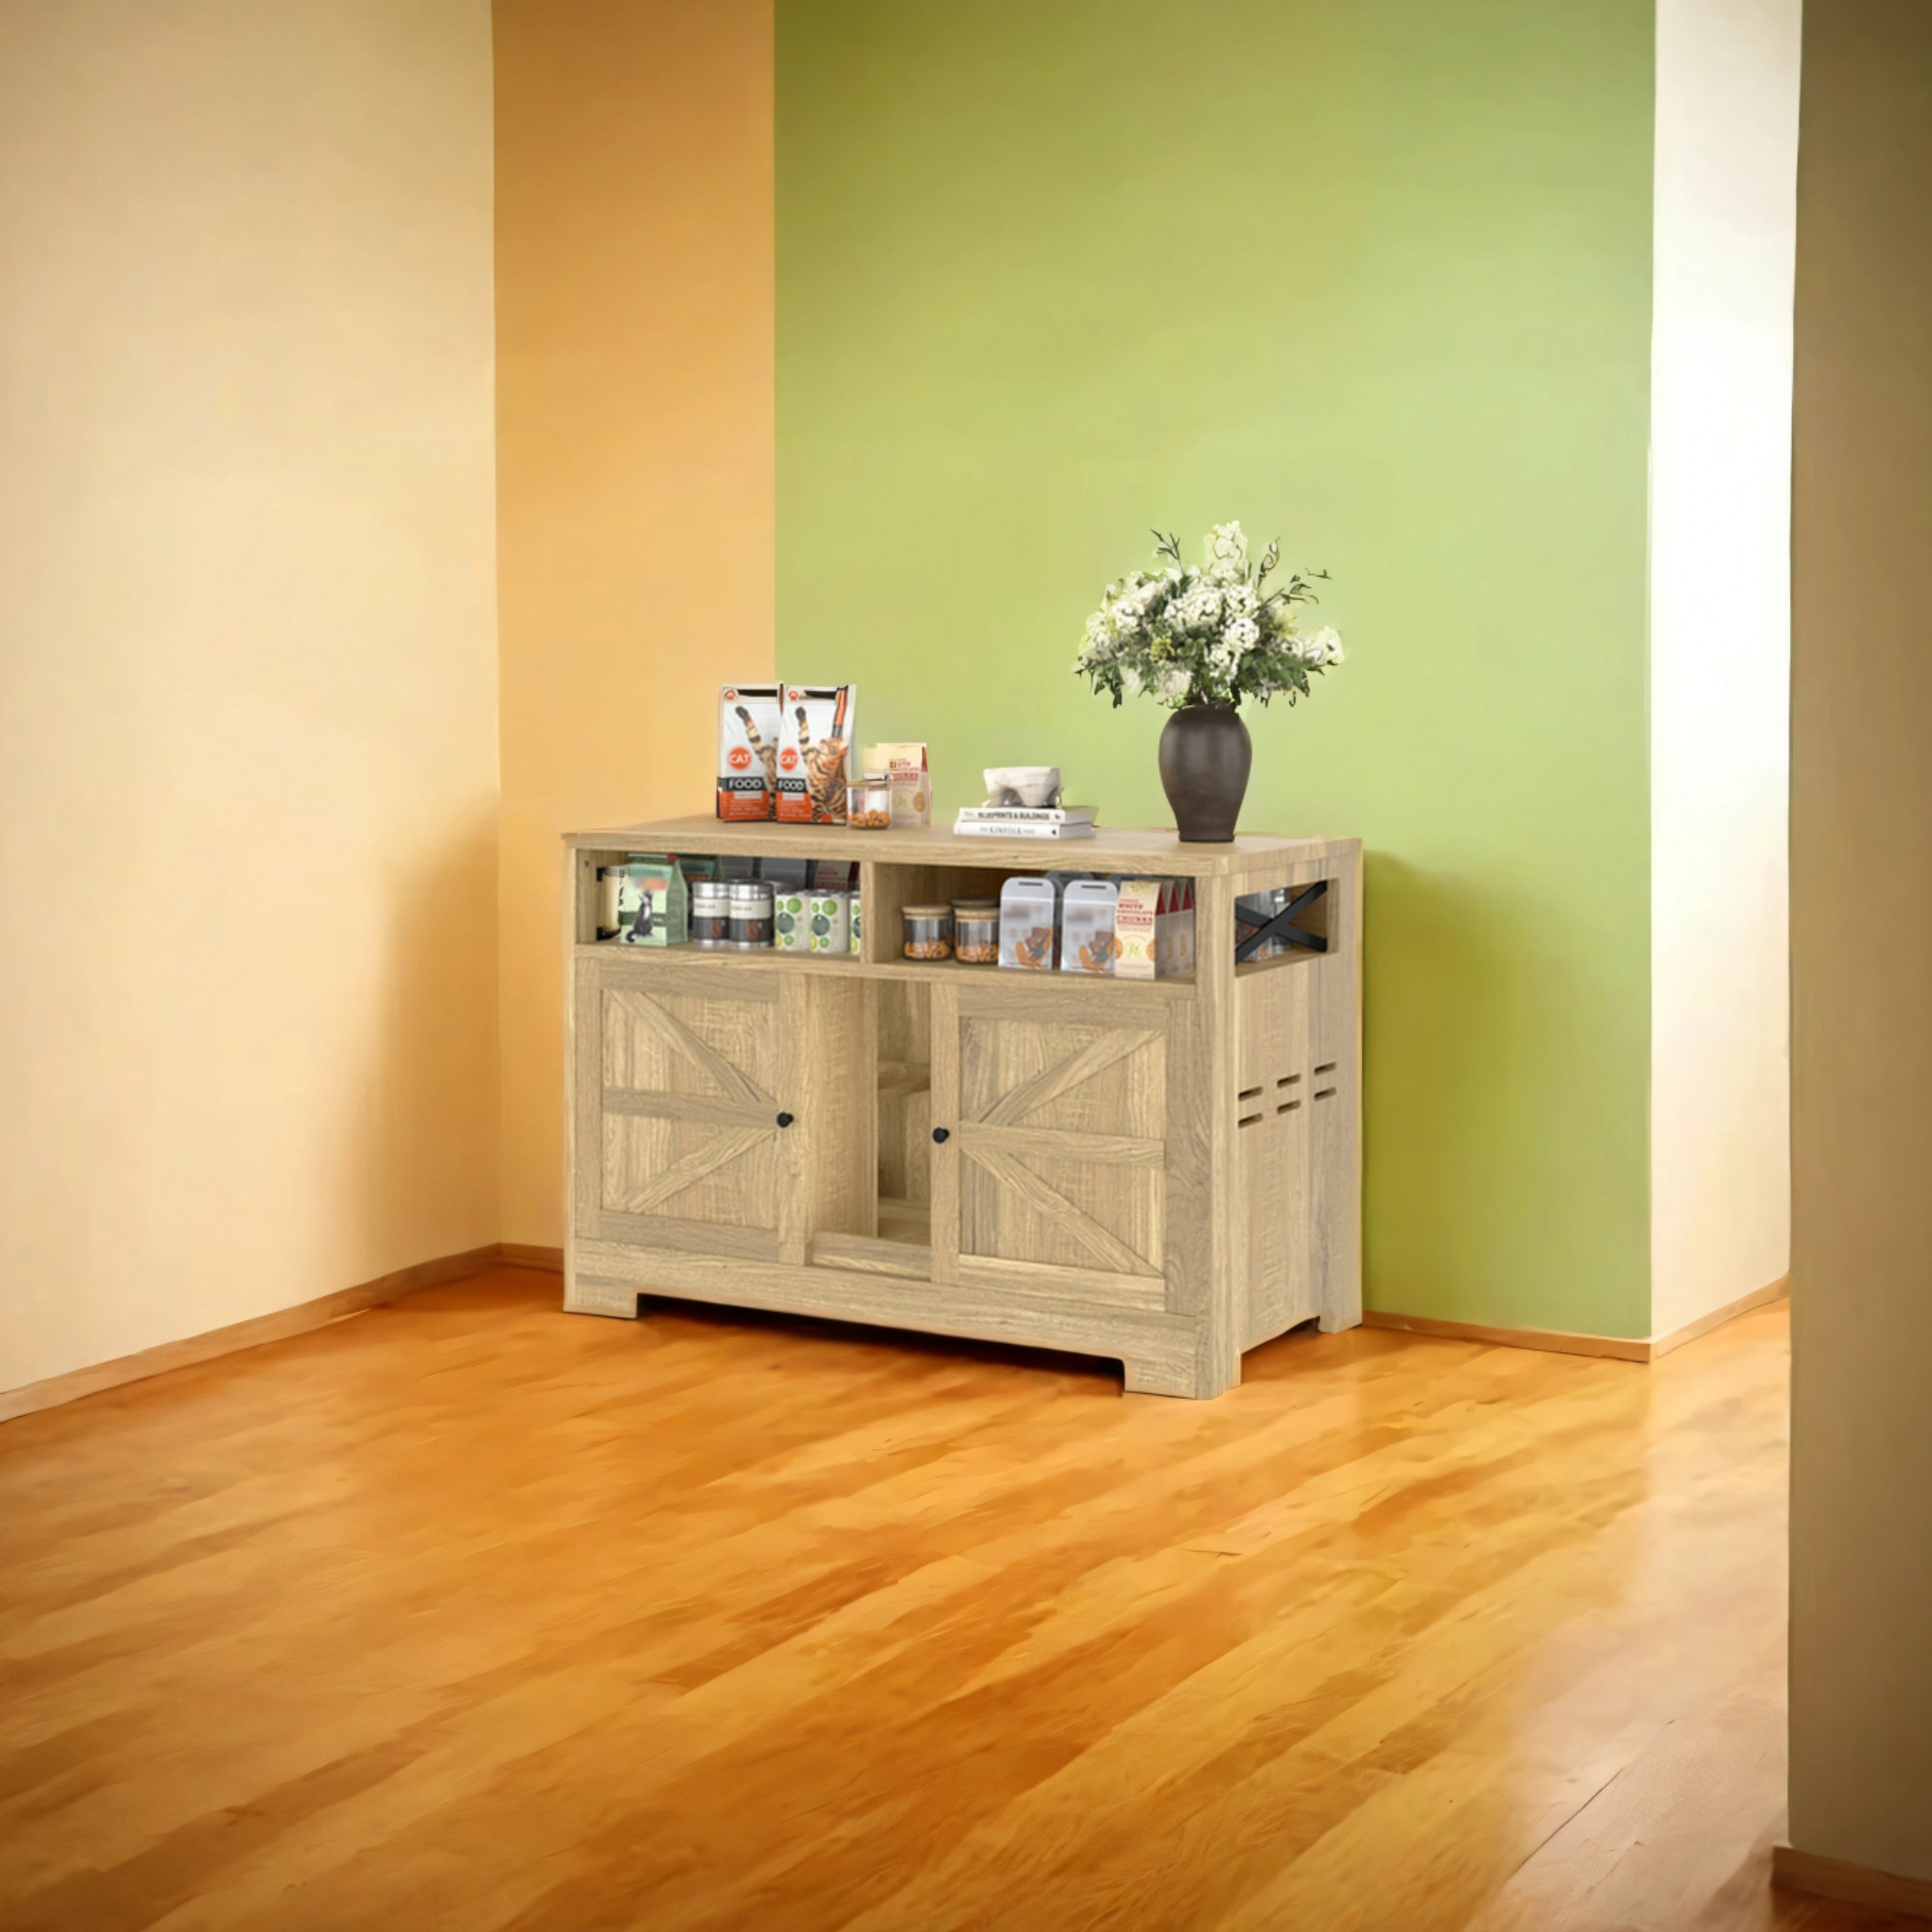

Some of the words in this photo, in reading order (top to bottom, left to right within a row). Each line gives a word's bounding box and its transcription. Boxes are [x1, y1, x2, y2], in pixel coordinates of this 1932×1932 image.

[727, 753, 751, 764] CAT
[779, 754, 798, 765] CAT
[728, 779, 762, 789] FOOD
[778, 780, 805, 790] FOOD
[1019, 811, 1050, 820] BUILDINGS
[989, 826, 1022, 835] KINFOLK
